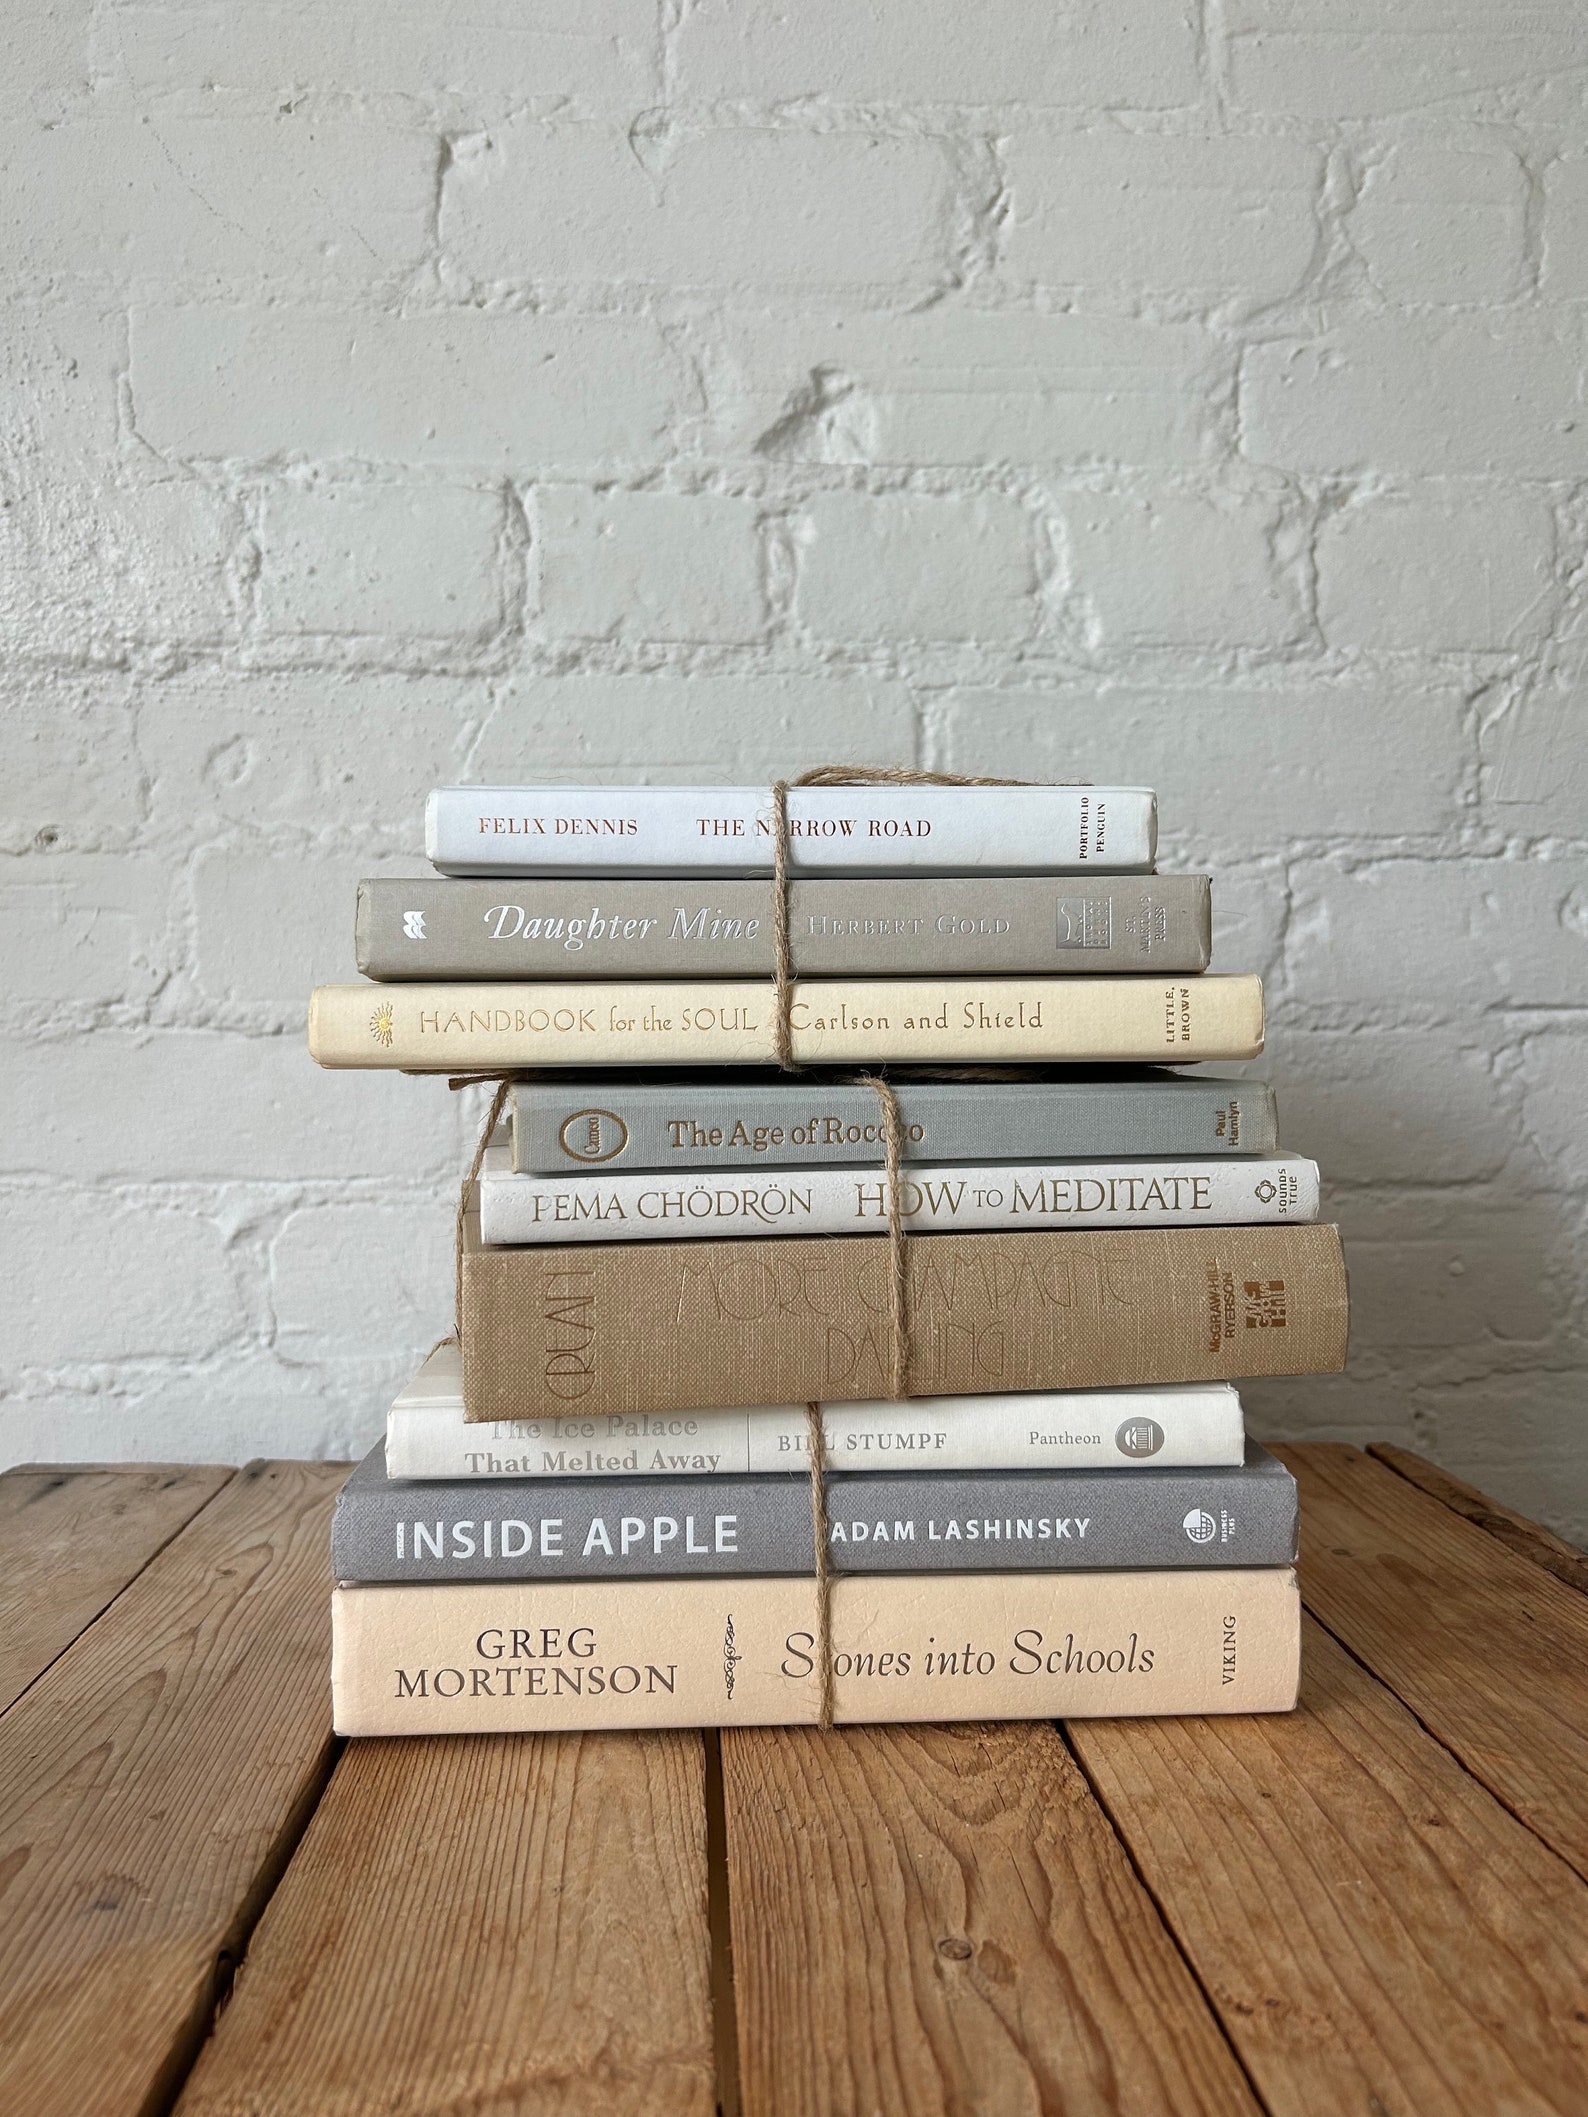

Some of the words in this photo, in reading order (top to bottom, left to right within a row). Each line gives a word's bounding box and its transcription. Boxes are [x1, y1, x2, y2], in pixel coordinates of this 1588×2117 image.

[479, 817, 547, 835] FELIX
[555, 818, 639, 836] DENNIS
[696, 819, 745, 836] THE
[756, 819, 857, 837] NRROW
[868, 820, 932, 837] ROAD
[1079, 796, 1089, 859] PORTFOLIO
[1096, 802, 1106, 853] PENGUIN
[483, 905, 657, 951] Daughter
[667, 907, 760, 940] Mine
[419, 1008, 598, 1034] HANDBOOK
[608, 1005, 636, 1032] for
[643, 1005, 673, 1032] the
[681, 1007, 759, 1032] SOUL
[788, 1002, 890, 1031] Carlson
[903, 1002, 949, 1030] and
[963, 1001, 1044, 1029] Shield
[1180, 988, 1191, 1042] BROWN
[667, 1120, 723, 1148] The
[727, 1121, 784, 1152] Age
[791, 1118, 819, 1145] of
[1216, 1110, 1226, 1137] Paul
[1228, 1101, 1240, 1147] Hamlyn
[532, 1193, 628, 1222] PEMA
[637, 1183, 813, 1224] CHÖDRÖN
[854, 1181, 968, 1217] HOW
[1009, 1176, 1215, 1214] MEDITATE
[1222, 1272, 1236, 1338] RYERSON
[488, 1417, 542, 1440] The
[552, 1415, 596, 1439] Ice
[606, 1413, 699, 1438] Palace
[846, 1432, 948, 1450] STUMPF
[1029, 1430, 1102, 1446] Pantheon
[464, 1452, 531, 1474] That
[541, 1449, 639, 1472] Melted
[649, 1448, 721, 1474] Away
[396, 1518, 564, 1560] INSIDE
[582, 1514, 739, 1556] APPLE
[830, 1520, 916, 1543] ADAM
[928, 1518, 1090, 1541] LASHINSKY
[476, 1626, 597, 1660] GREG
[780, 1631, 912, 1679] Sones
[924, 1636, 996, 1676] into
[1009, 1628, 1155, 1676] Schools
[1222, 1615, 1238, 1686] VIKING
[394, 1664, 678, 1699] MORTENSON
